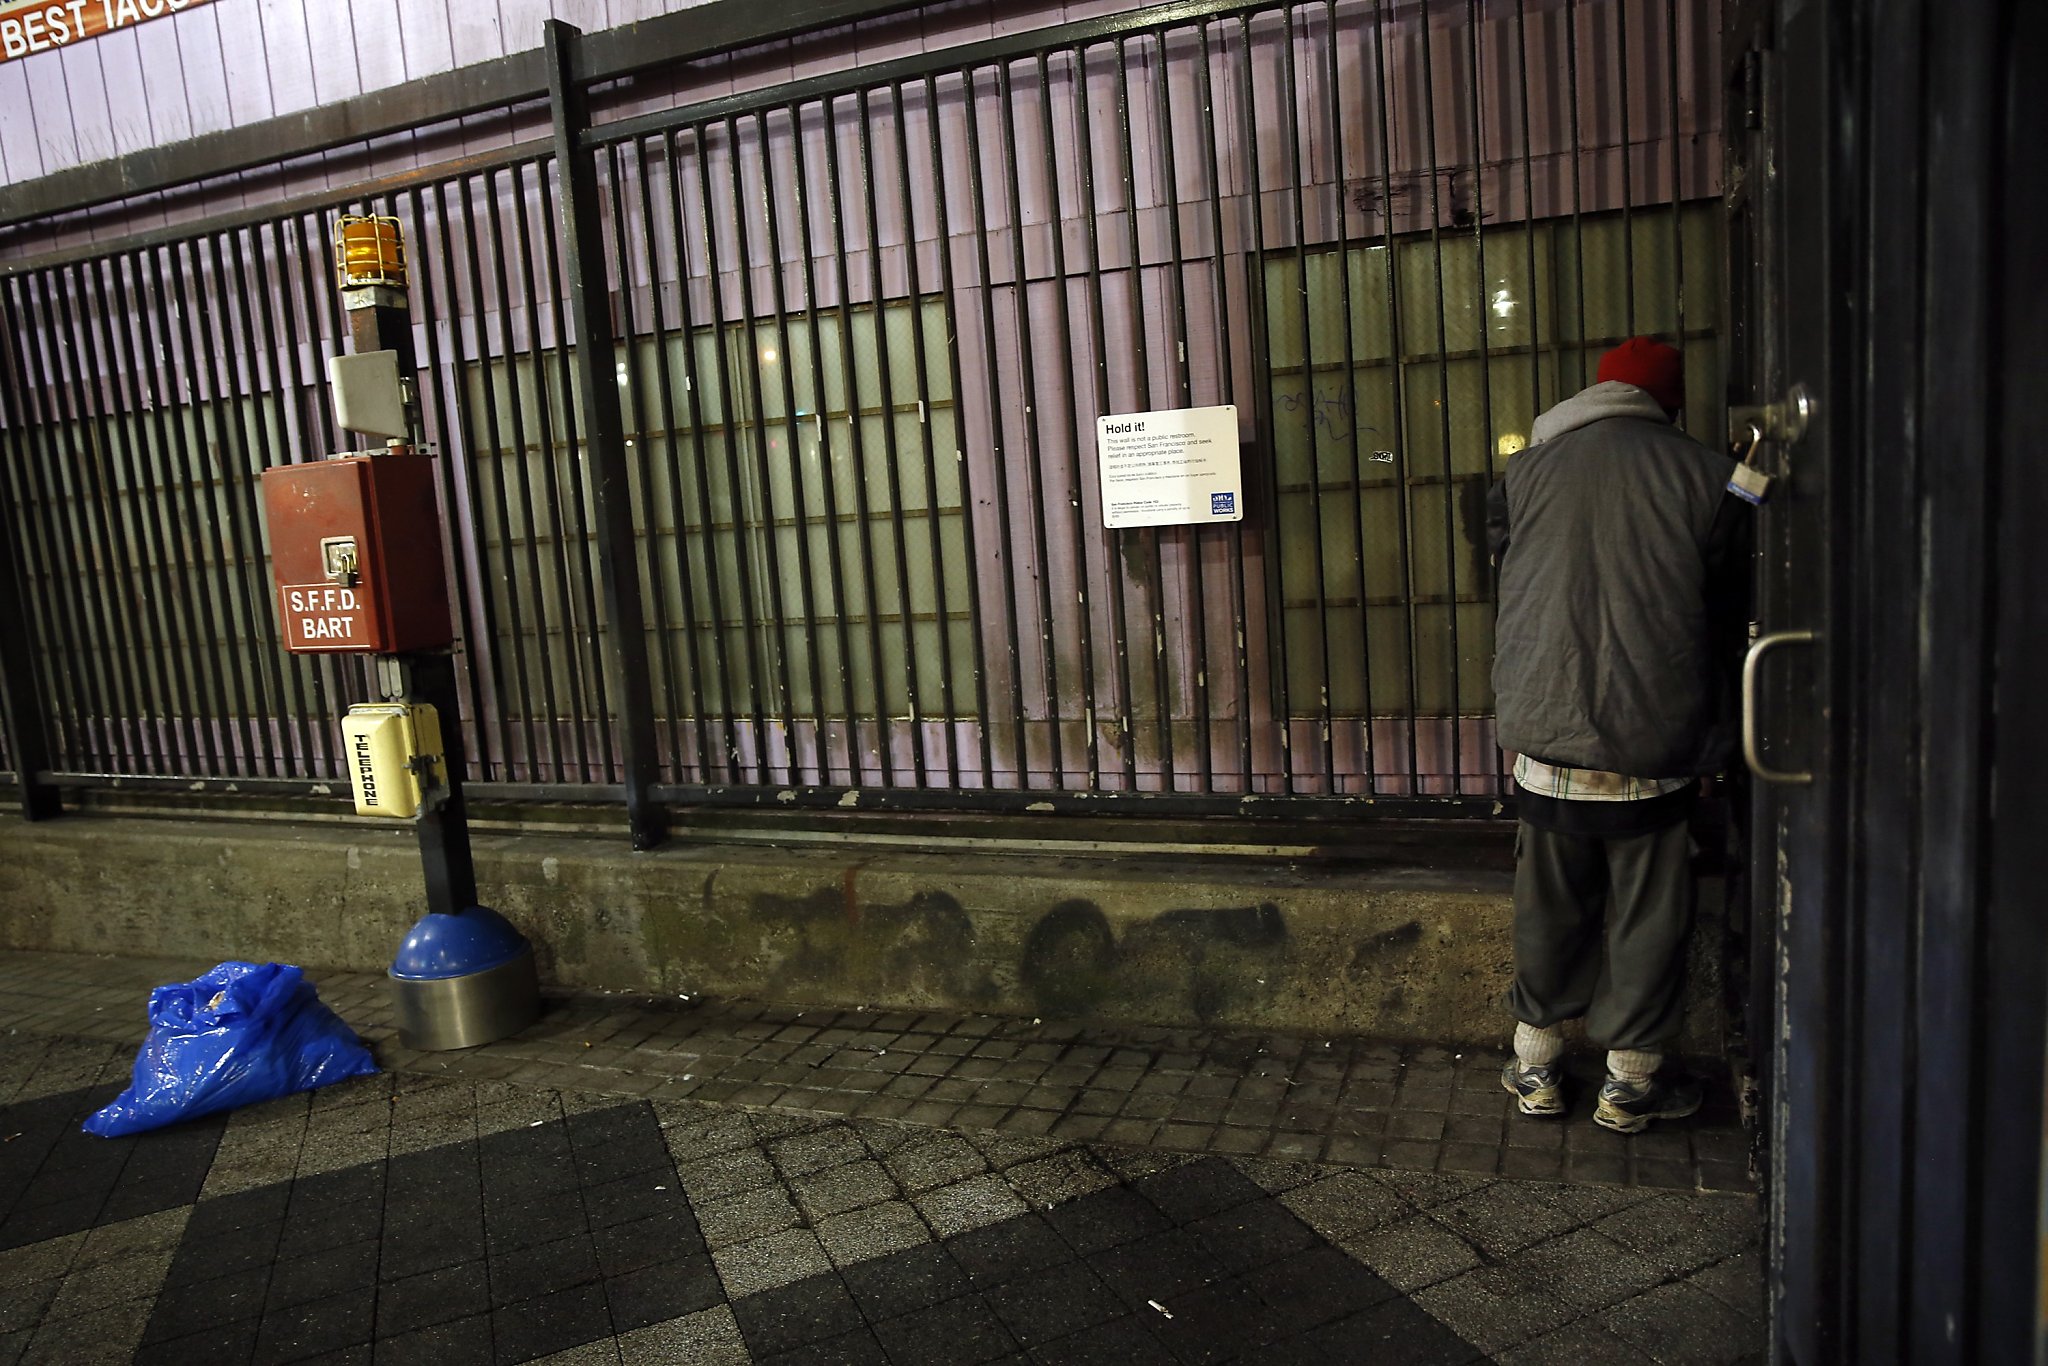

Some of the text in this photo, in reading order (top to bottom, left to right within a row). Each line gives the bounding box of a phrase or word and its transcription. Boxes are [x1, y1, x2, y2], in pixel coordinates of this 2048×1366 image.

[1, 0, 189, 58] BEST TAC
[1106, 421, 1145, 434] Hold it!
[1136, 449, 1167, 457] appropriate
[291, 589, 361, 613] S.F.F.D.
[302, 617, 353, 639] BART
[354, 734, 379, 807] TELEPHONE
